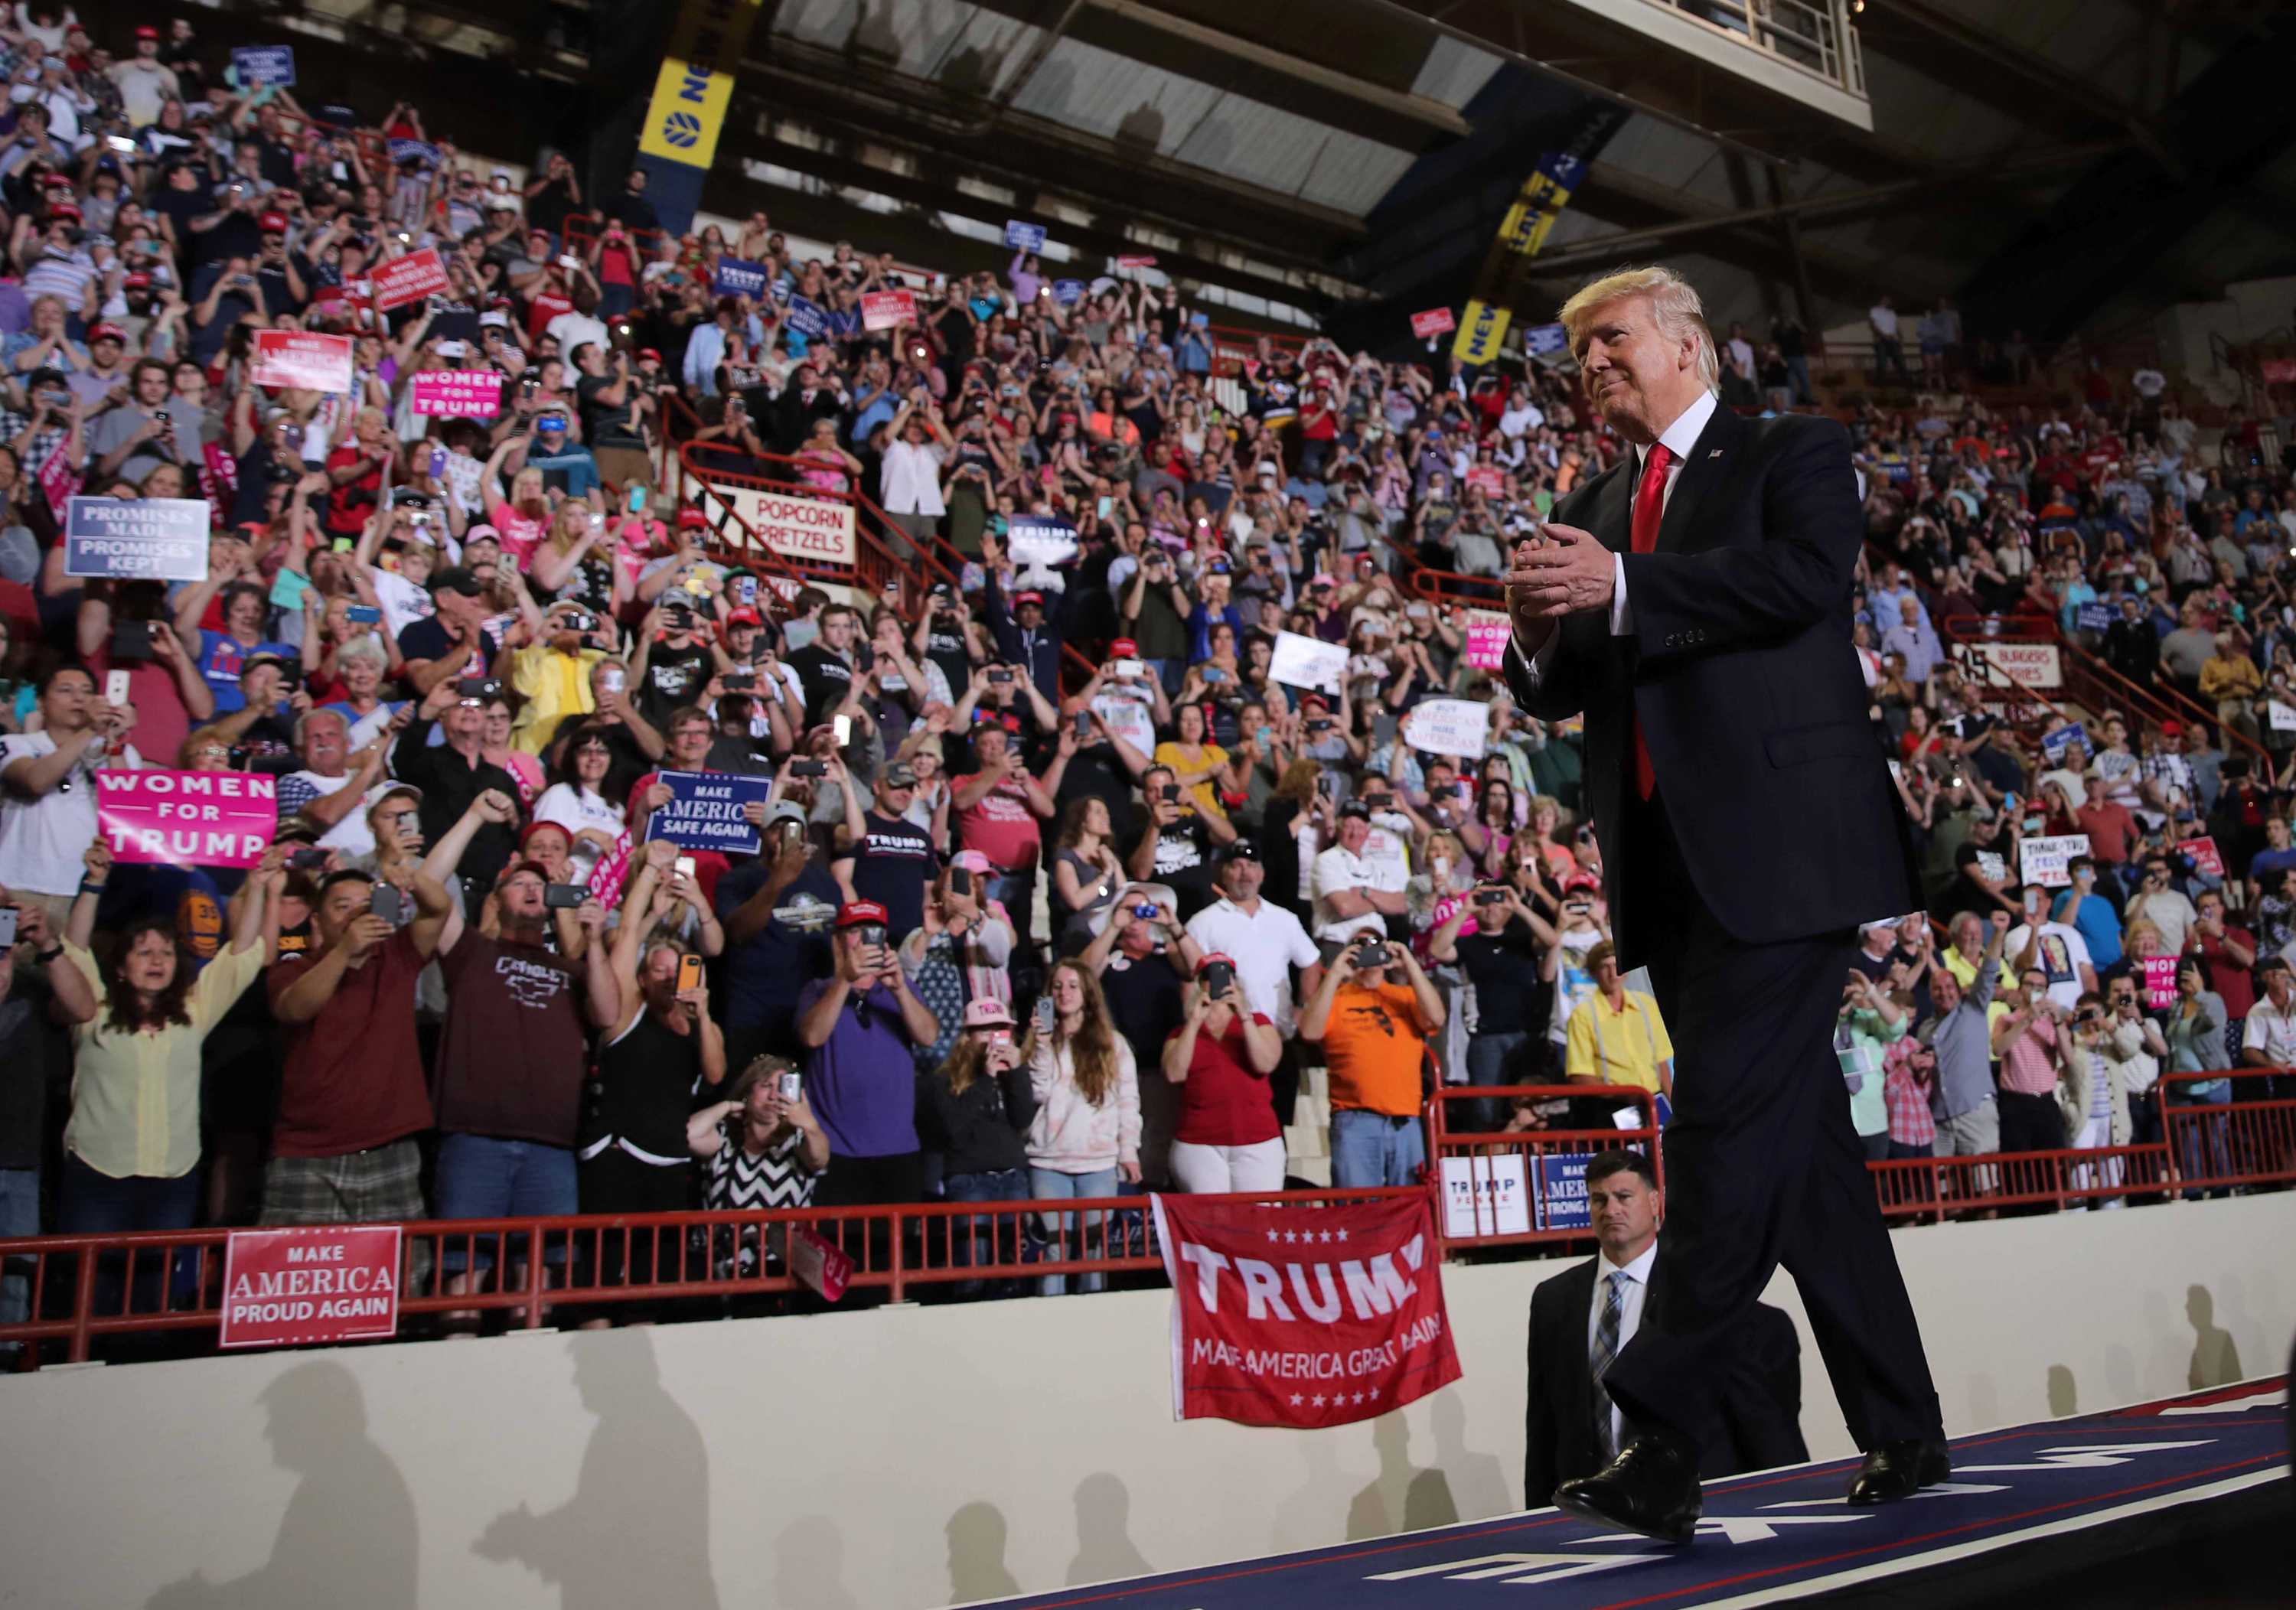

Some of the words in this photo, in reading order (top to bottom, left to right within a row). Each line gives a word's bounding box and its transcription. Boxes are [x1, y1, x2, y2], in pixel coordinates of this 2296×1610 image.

[416, 372, 502, 388] WOMEN
[441, 387, 473, 399] FOR
[417, 399, 496, 415] TRUMP
[83, 506, 193, 522] PROMISES
[758, 499, 843, 529] POPCORN
[79, 539, 192, 558] PROMISES
[758, 523, 844, 554] PRETZELS
[108, 556, 161, 572] KEPT
[99, 774, 276, 799] WOMEN
[694, 785, 732, 799] MAKE
[158, 802, 220, 822] FOR
[654, 799, 745, 822] AMERIC
[662, 819, 700, 835] SAFE
[700, 822, 750, 839] AGAIN
[106, 826, 266, 859] TRUMP
[866, 833, 926, 849] TRUMP
[590, 829, 634, 895] OMEN
[282, 1245, 344, 1263] MAKE
[230, 1265, 395, 1299] AMERICA
[233, 1301, 315, 1325] PROUD
[318, 1296, 389, 1320] AGAIN
[1245, 1348, 1345, 1379] AMERICA
